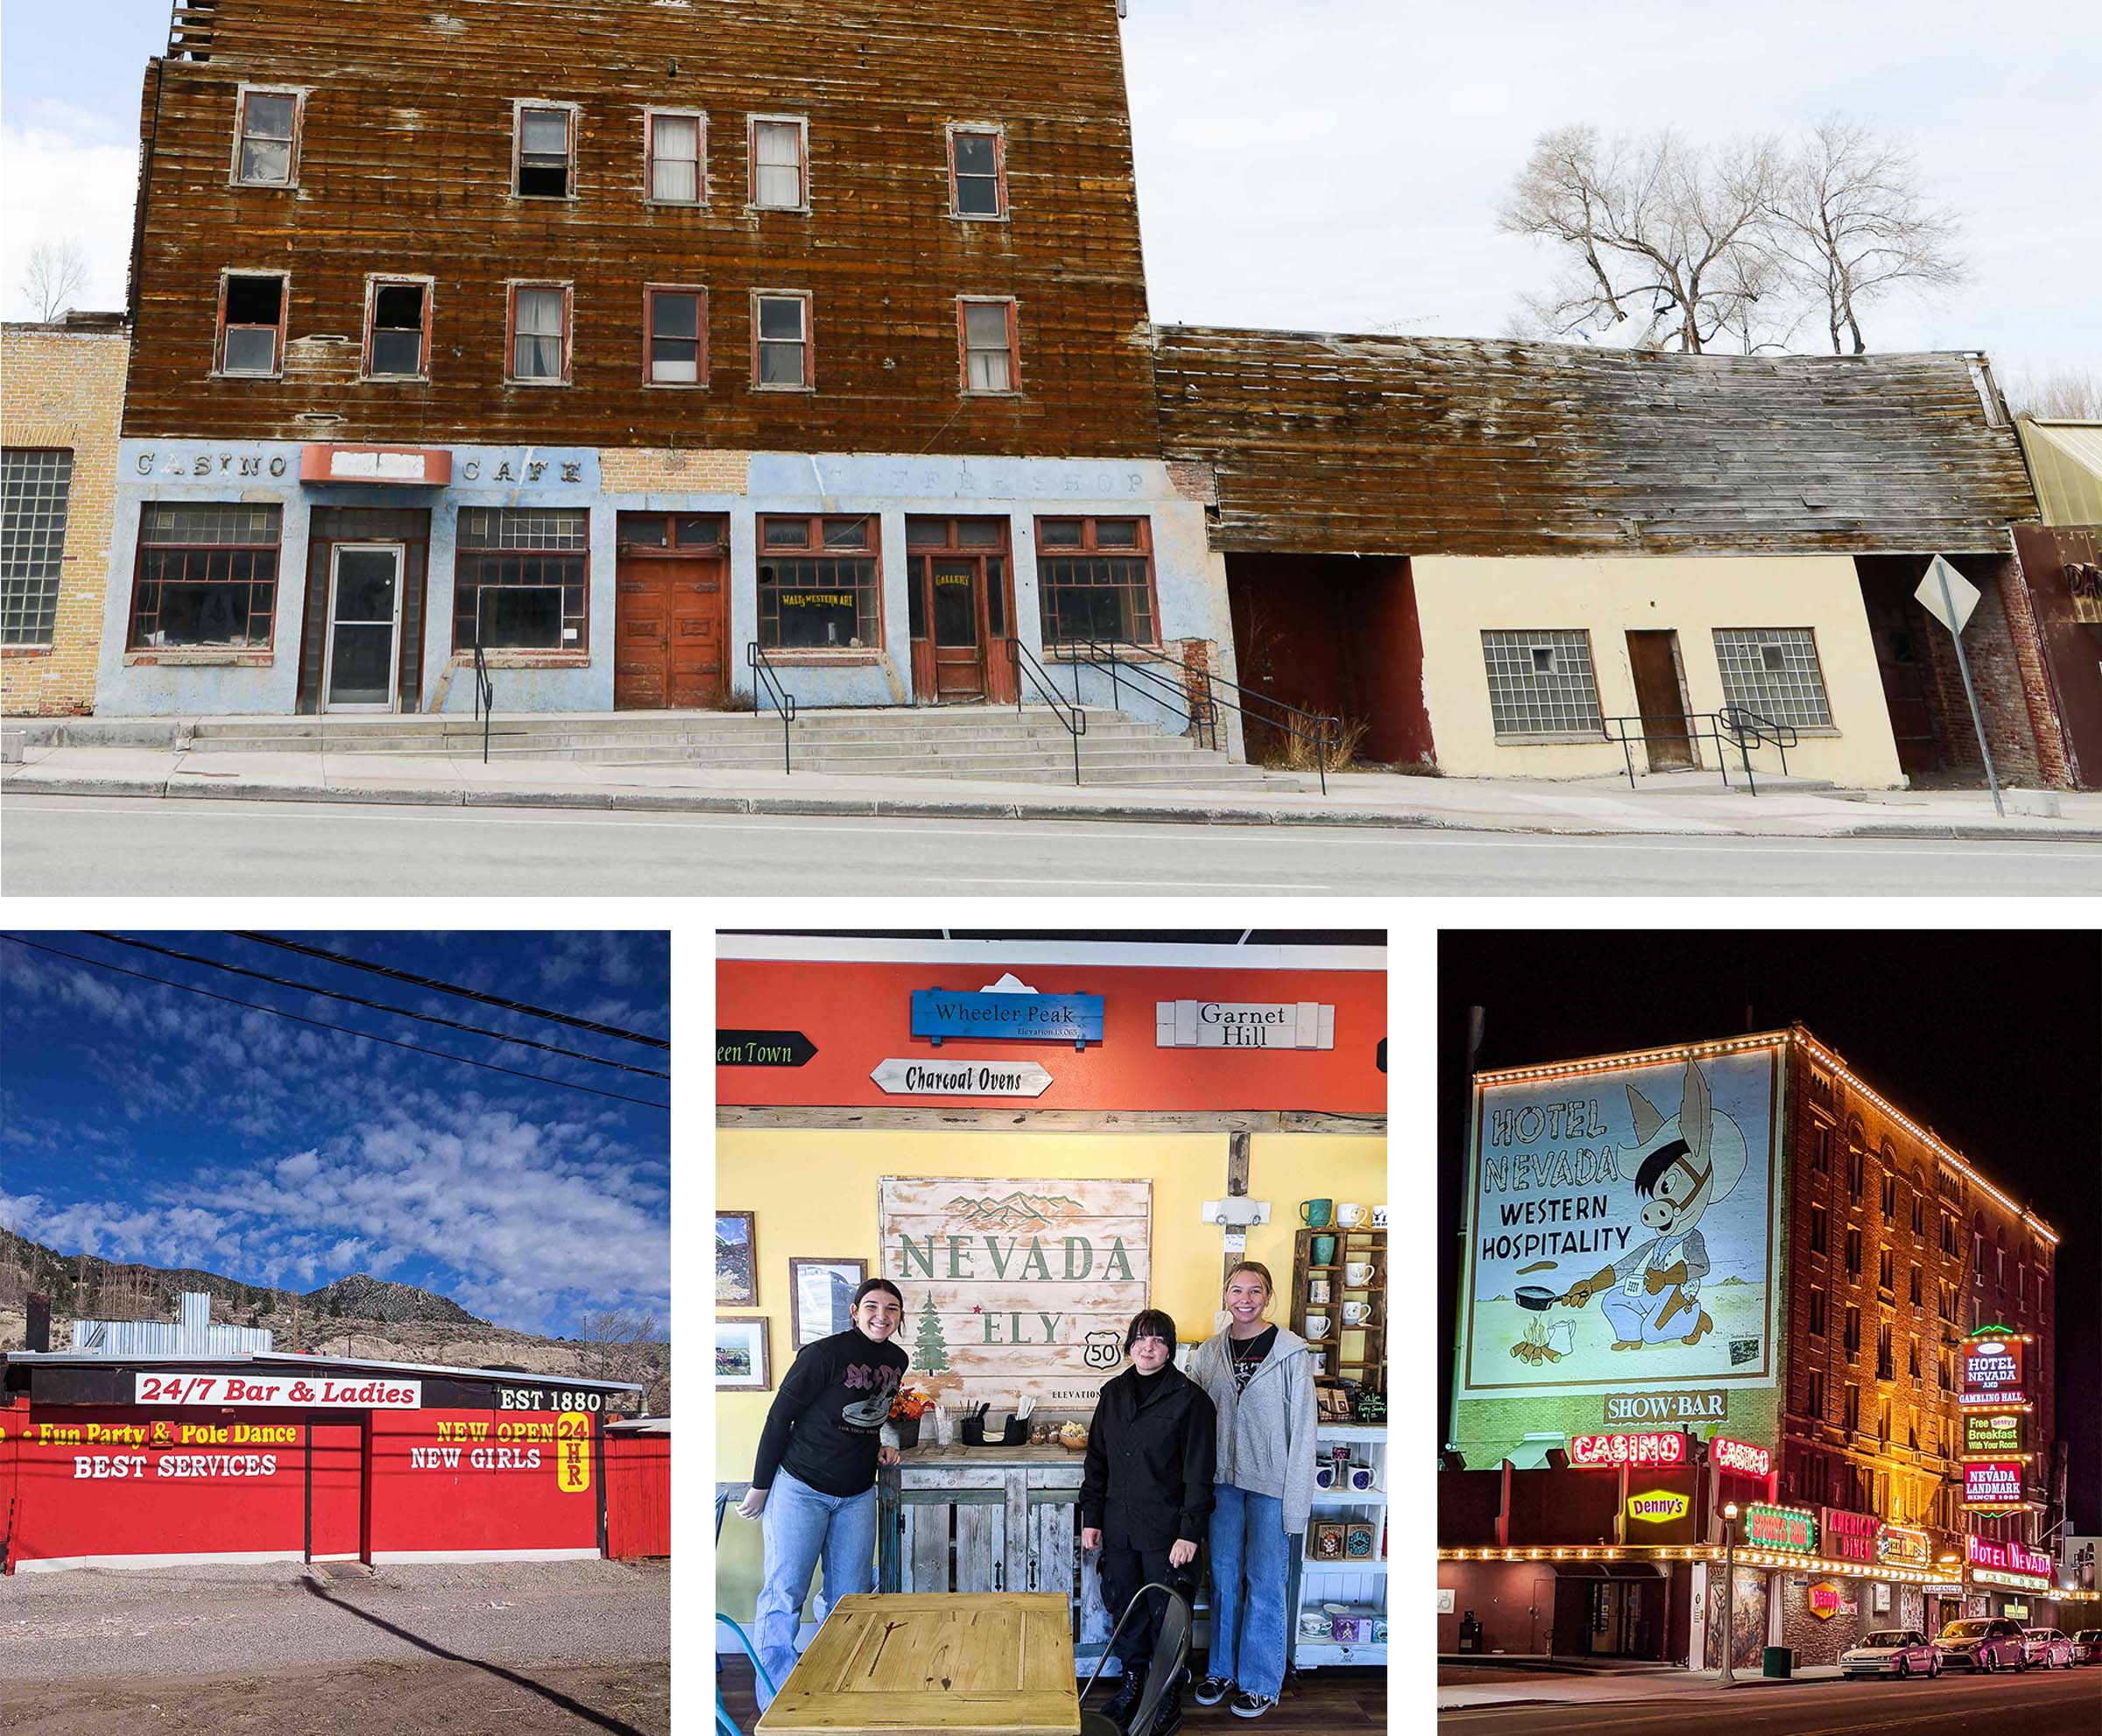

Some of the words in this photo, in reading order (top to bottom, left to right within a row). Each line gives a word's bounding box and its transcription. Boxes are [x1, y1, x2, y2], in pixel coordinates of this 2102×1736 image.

[135, 451, 287, 477] CASINO
[462, 460, 582, 483] CAFE
[935, 575, 970, 587] GALLERY
[806, 595, 838, 605] WESTERN
[839, 595, 853, 607] ART
[935, 1004, 1022, 1022] Wheeler
[1028, 1006, 1074, 1023] Peak
[1201, 1003, 1285, 1024] Garnet
[1223, 1026, 1267, 1046] Hill
[744, 1042, 792, 1062] Town
[906, 1066, 972, 1091] Charcoal
[979, 1068, 1022, 1090] Ovens
[1492, 1098, 1607, 1147] HOTEL
[1485, 1145, 1619, 1193] NEVADA
[1500, 1195, 1608, 1225] WESTERN
[1482, 1226, 1632, 1260] HOSPITALITY
[899, 1233, 1135, 1281] NEVADA
[982, 1312, 1063, 1344] ELY
[1091, 1344, 1115, 1361] 50
[1968, 1357, 2016, 1371] HOTEL
[1968, 1371, 2016, 1381] NEVADA
[141, 1379, 216, 1405] 24/7
[224, 1380, 280, 1401] Bar
[288, 1381, 315, 1401] &
[321, 1381, 414, 1403] Ladies
[500, 1389, 545, 1410] EST
[550, 1392, 601, 1412] 1880
[1958, 1394, 2000, 1403] GAMBLING
[2001, 1393, 2023, 1401] HALL
[437, 1422, 489, 1443] NEW
[497, 1422, 554, 1443] OPEN
[558, 1420, 588, 1442] 24
[1970, 1418, 1989, 1428] Free
[39, 1423, 81, 1446] Fun
[88, 1424, 145, 1450] Party
[153, 1422, 171, 1443] &
[181, 1424, 229, 1443] Pole
[233, 1424, 296, 1443] Dance
[1969, 1429, 2018, 1440] Breakfast
[1969, 1441, 1982, 1450] With
[1999, 1441, 2018, 1450] Room
[411, 1448, 461, 1469] NEW
[470, 1448, 540, 1469] GIRLS
[1573, 1434, 1680, 1464] CASINO
[1716, 1438, 1769, 1476] CASINO
[74, 1456, 147, 1478] BEST
[158, 1455, 277, 1478] SERVICES
[1970, 1471, 2016, 1483] NEVADA
[1966, 1483, 2021, 1494] LANDMARK
[1633, 1498, 1684, 1516] Denny's
[1752, 1514, 1787, 1542] SPORTS
[1789, 1519, 1808, 1545] BAR
[1842, 1536, 1871, 1560] DINER
[1970, 1535, 2007, 1567] HOTEL
[2010, 1542, 2051, 1574] NEVADA
